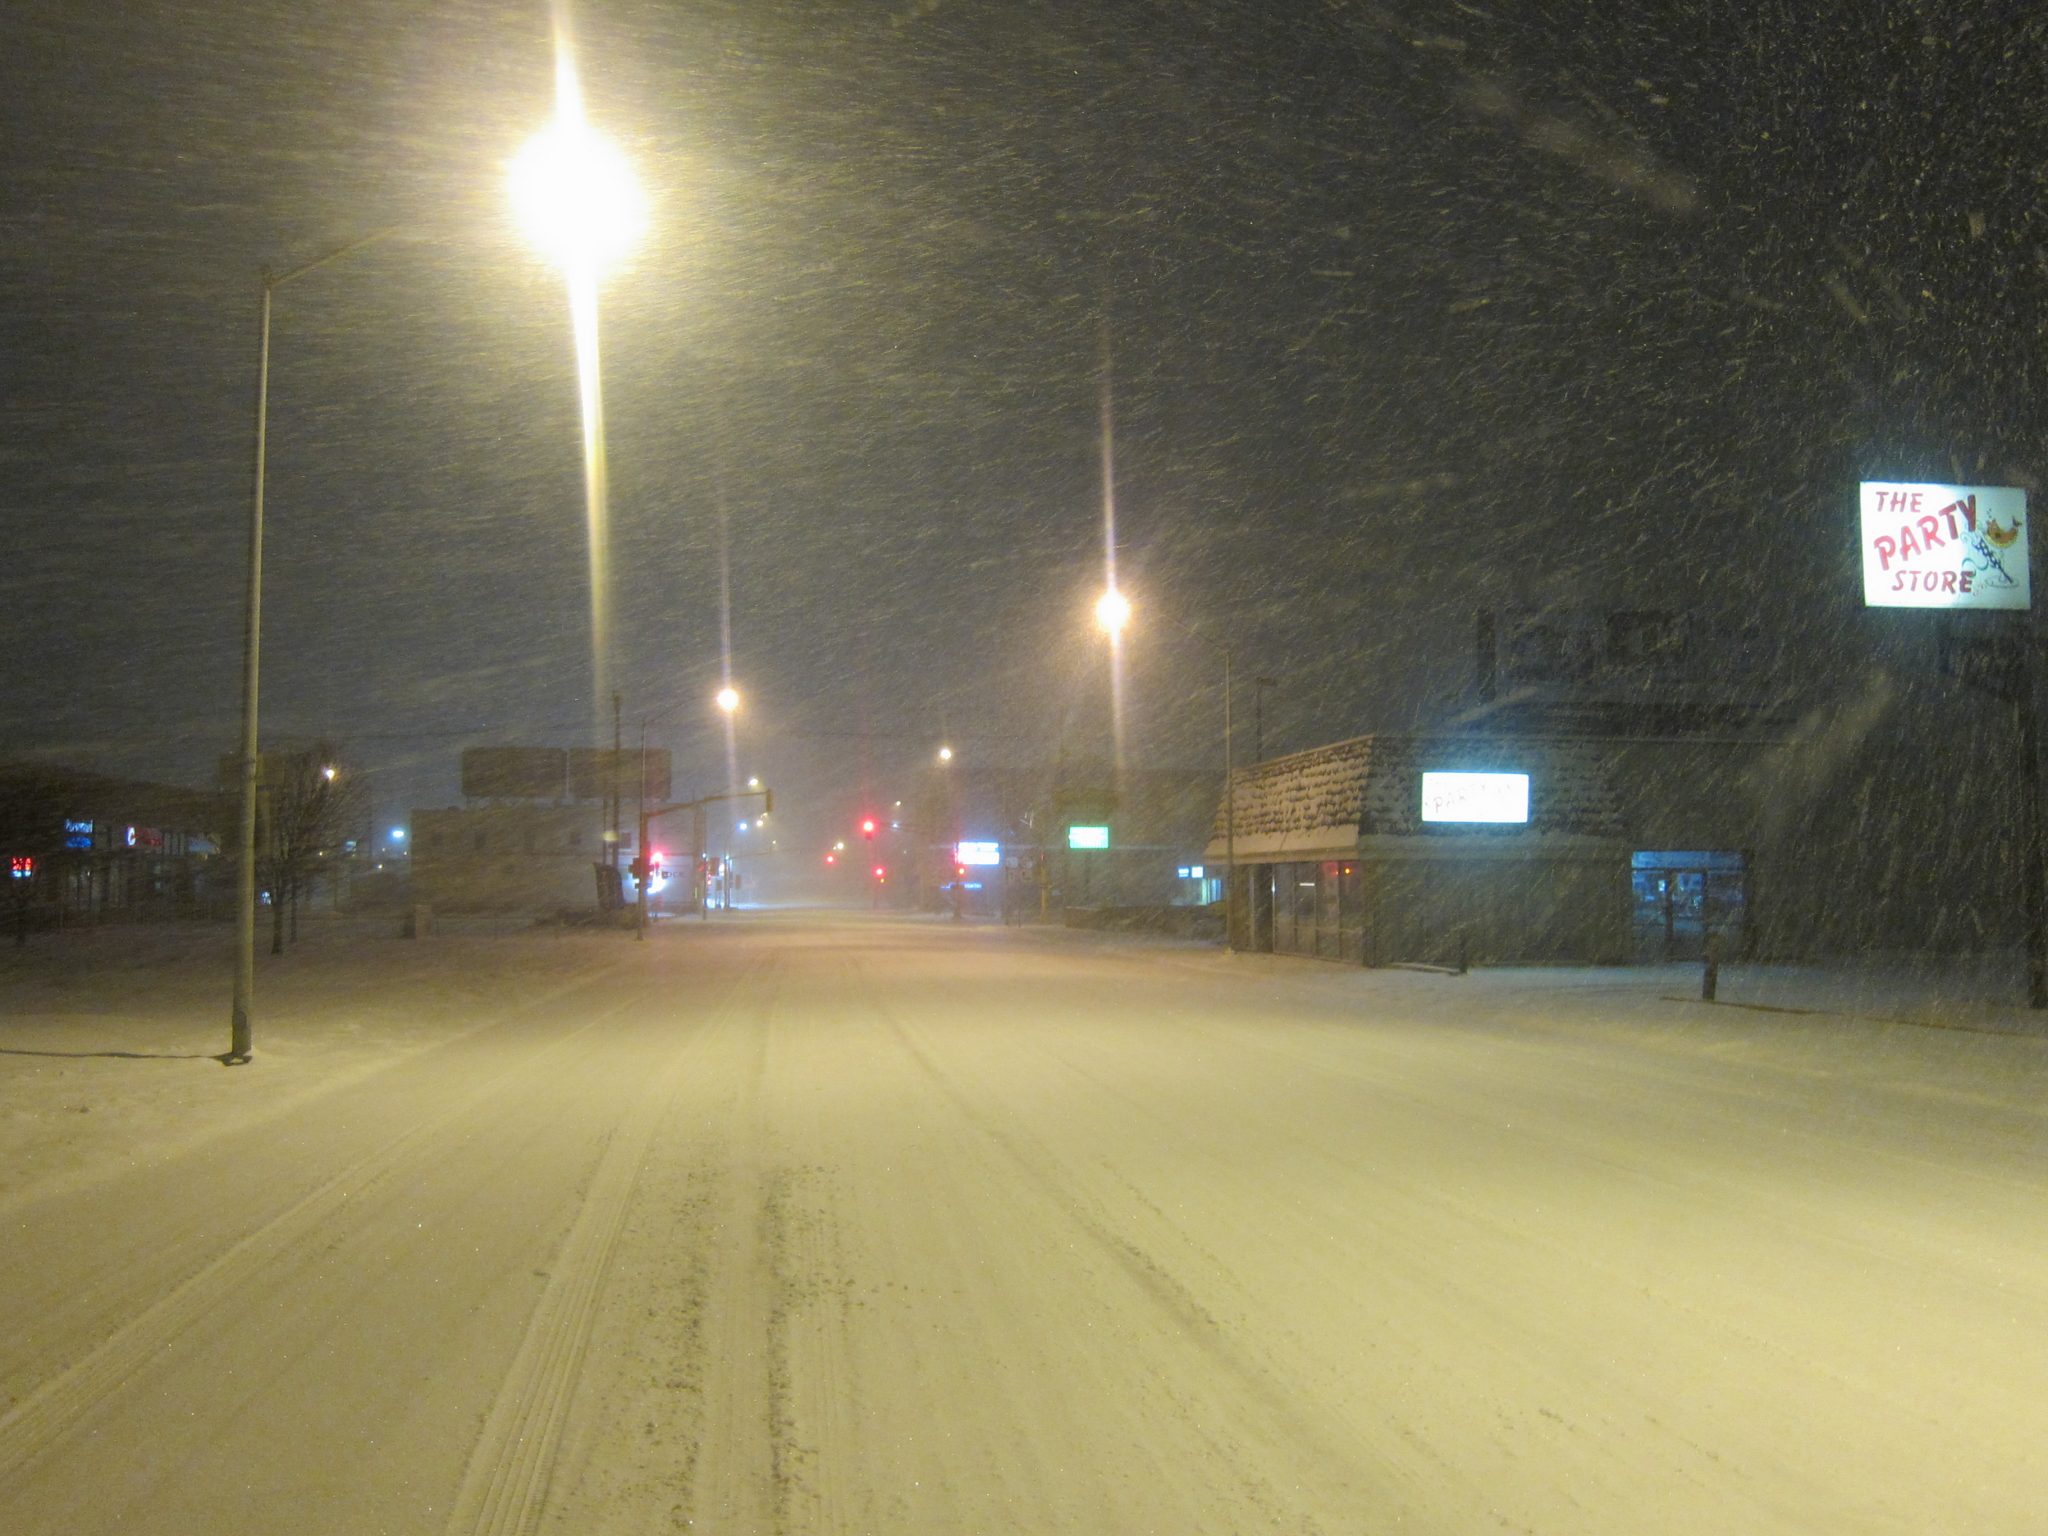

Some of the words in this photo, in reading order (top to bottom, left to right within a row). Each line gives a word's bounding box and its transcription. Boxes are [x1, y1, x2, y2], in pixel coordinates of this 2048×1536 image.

[1875, 491, 1923, 513] THE
[1873, 494, 1977, 571] PARTY
[1891, 569, 1974, 595] STORE
